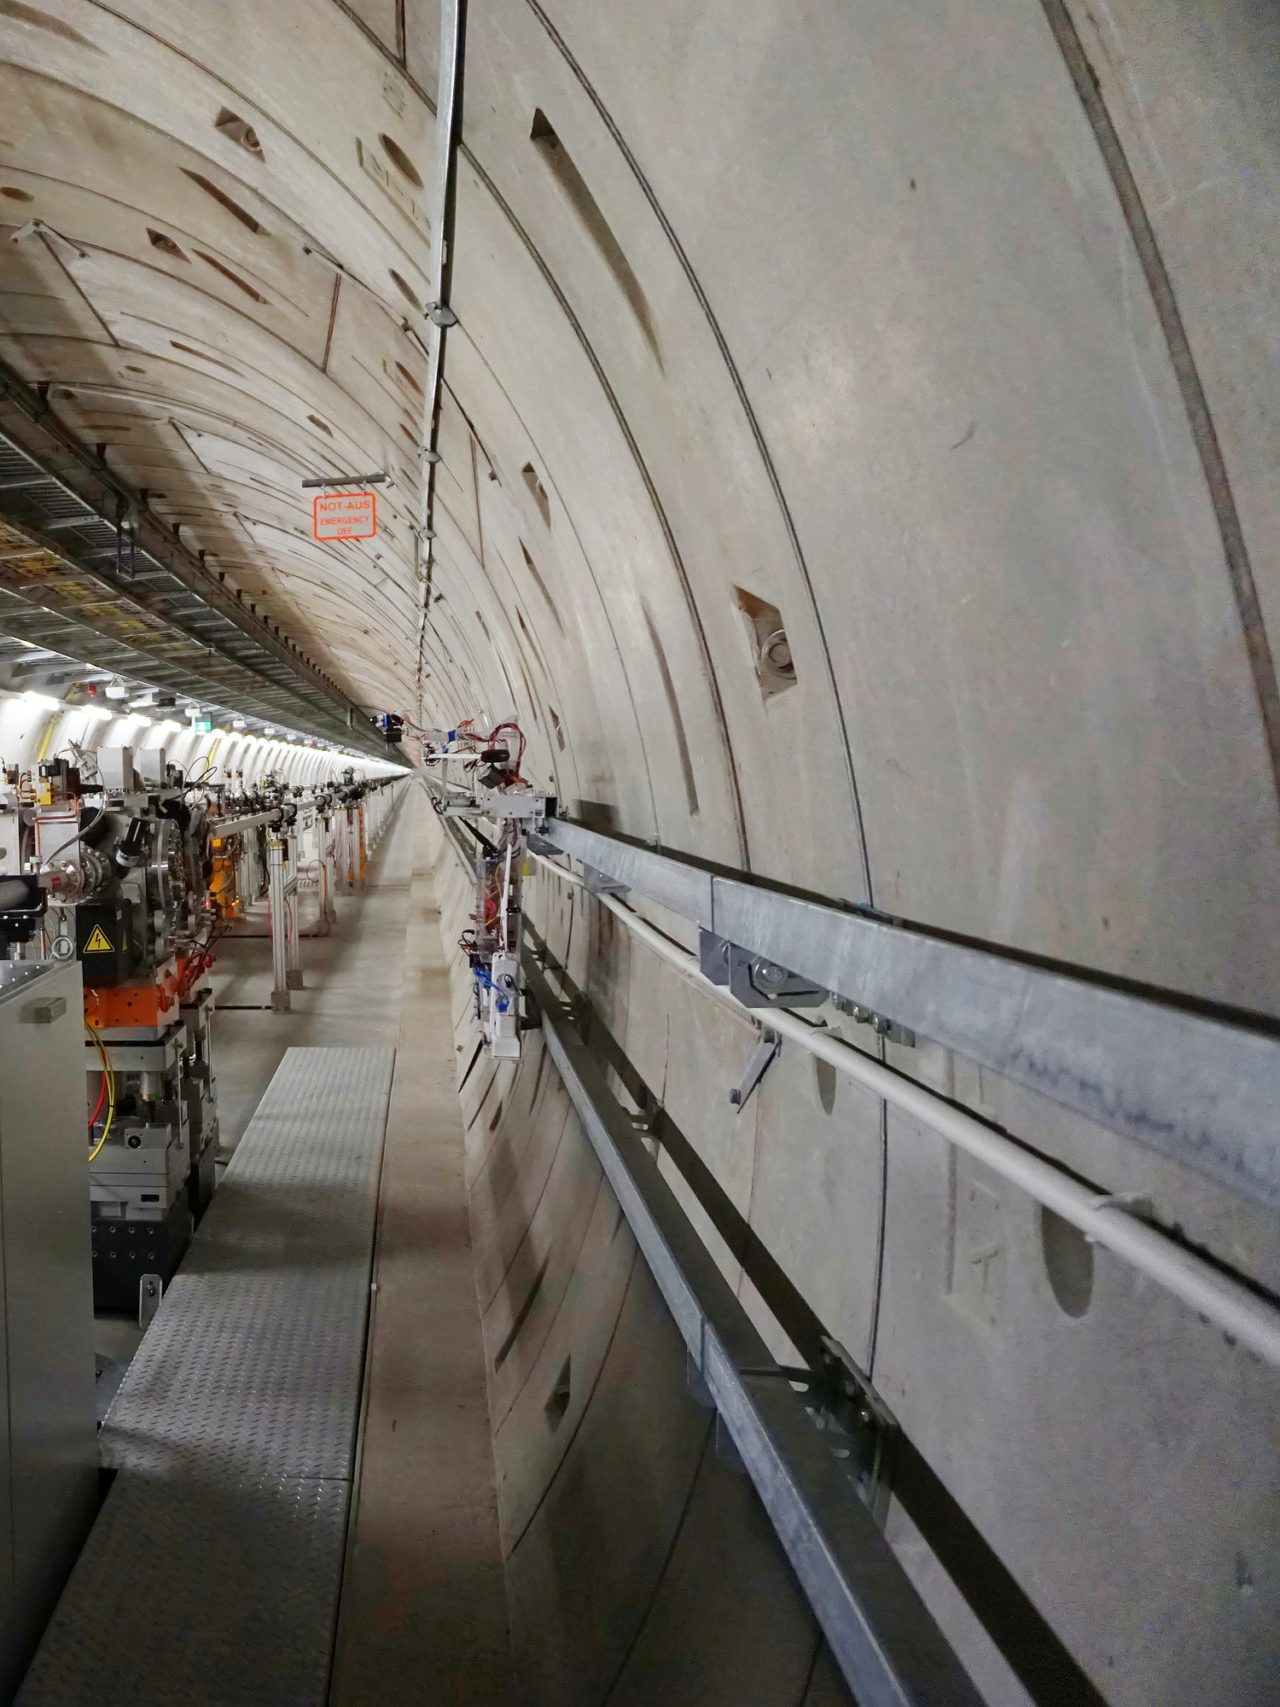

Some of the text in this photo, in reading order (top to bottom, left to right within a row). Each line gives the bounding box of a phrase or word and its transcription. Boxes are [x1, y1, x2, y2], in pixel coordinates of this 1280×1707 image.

[320, 500, 370, 511] NOT-AUS
[320, 516, 369, 526] EMERGENCY
[337, 527, 353, 536] OFF
